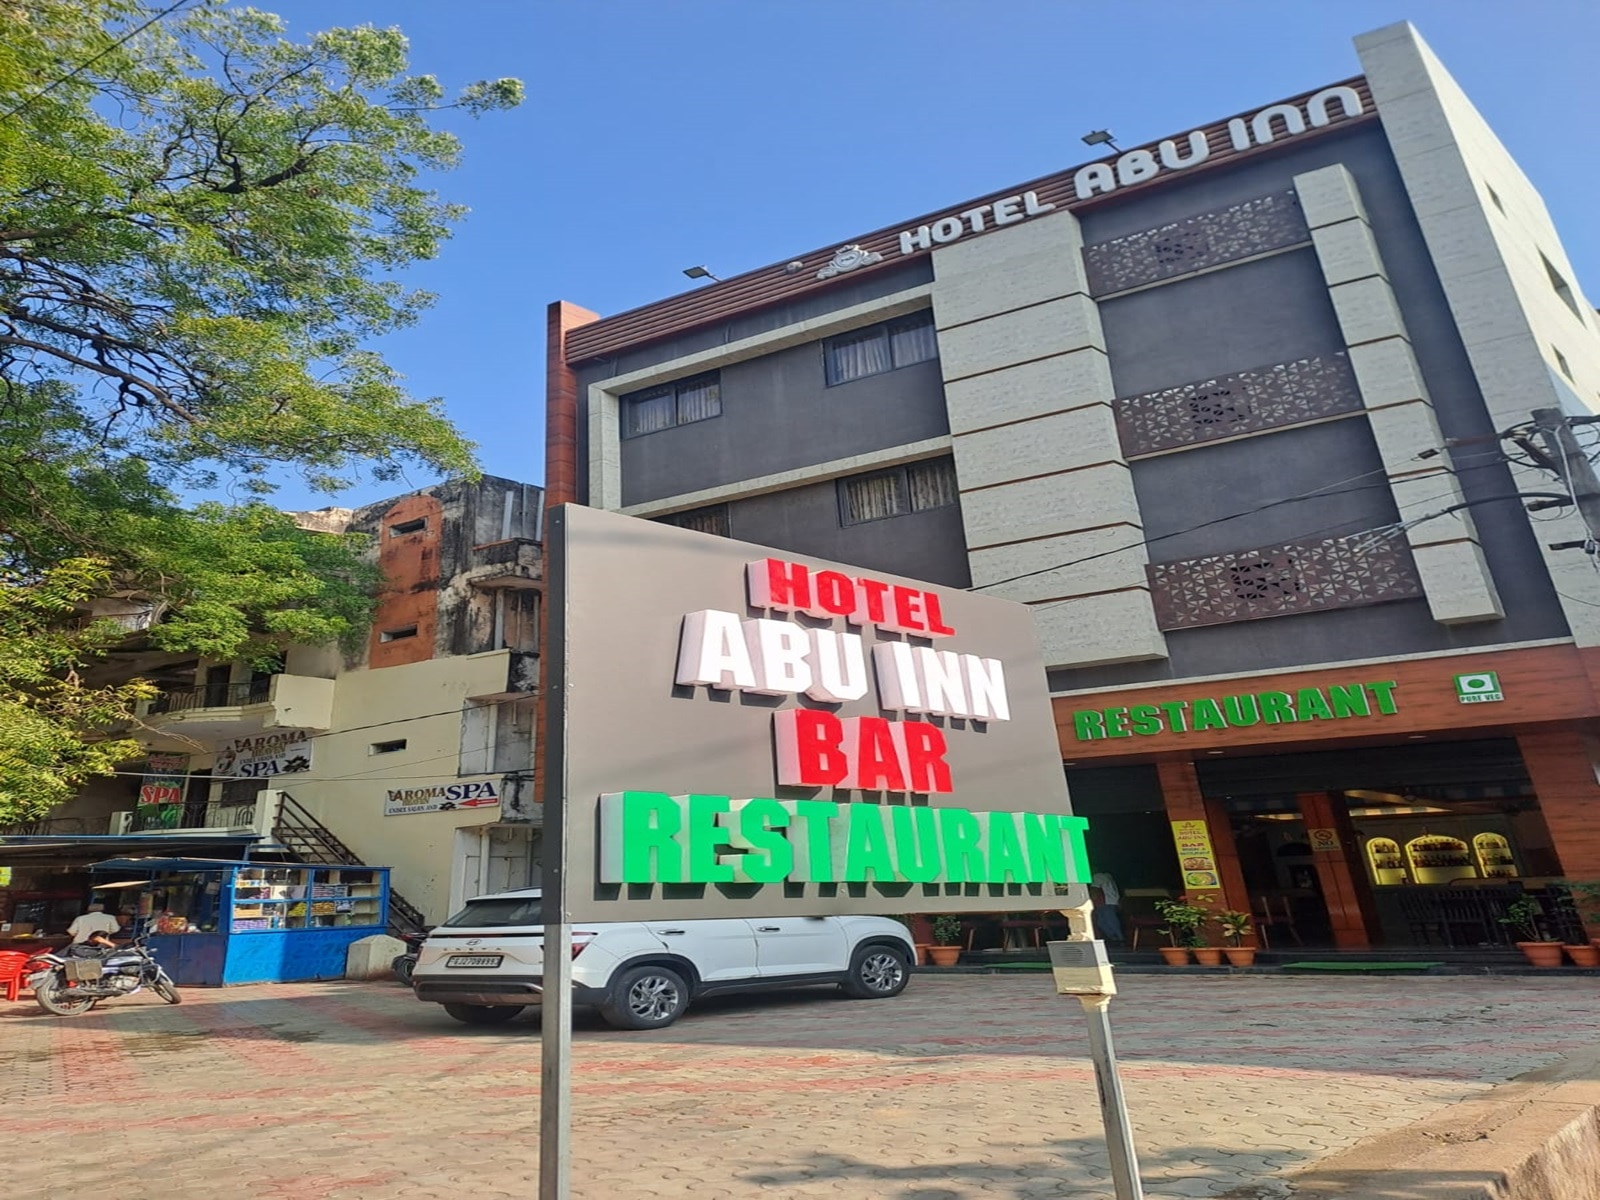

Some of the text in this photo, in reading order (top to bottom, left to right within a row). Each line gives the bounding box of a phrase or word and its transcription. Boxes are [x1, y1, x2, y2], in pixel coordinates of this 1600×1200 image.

[899, 190, 1056, 254] HOTEL
[1073, 130, 1210, 199] ABU
[748, 557, 955, 638] HOTEL
[676, 609, 1011, 721] ABU INN
[234, 730, 308, 753] AROMA
[1073, 680, 1398, 740] RESTAURANT
[240, 760, 280, 778] SPA
[775, 708, 953, 793] BAR
[141, 785, 182, 804] SPA
[387, 781, 497, 802] AROMA SPA
[599, 791, 1092, 884] RESTAURANT
